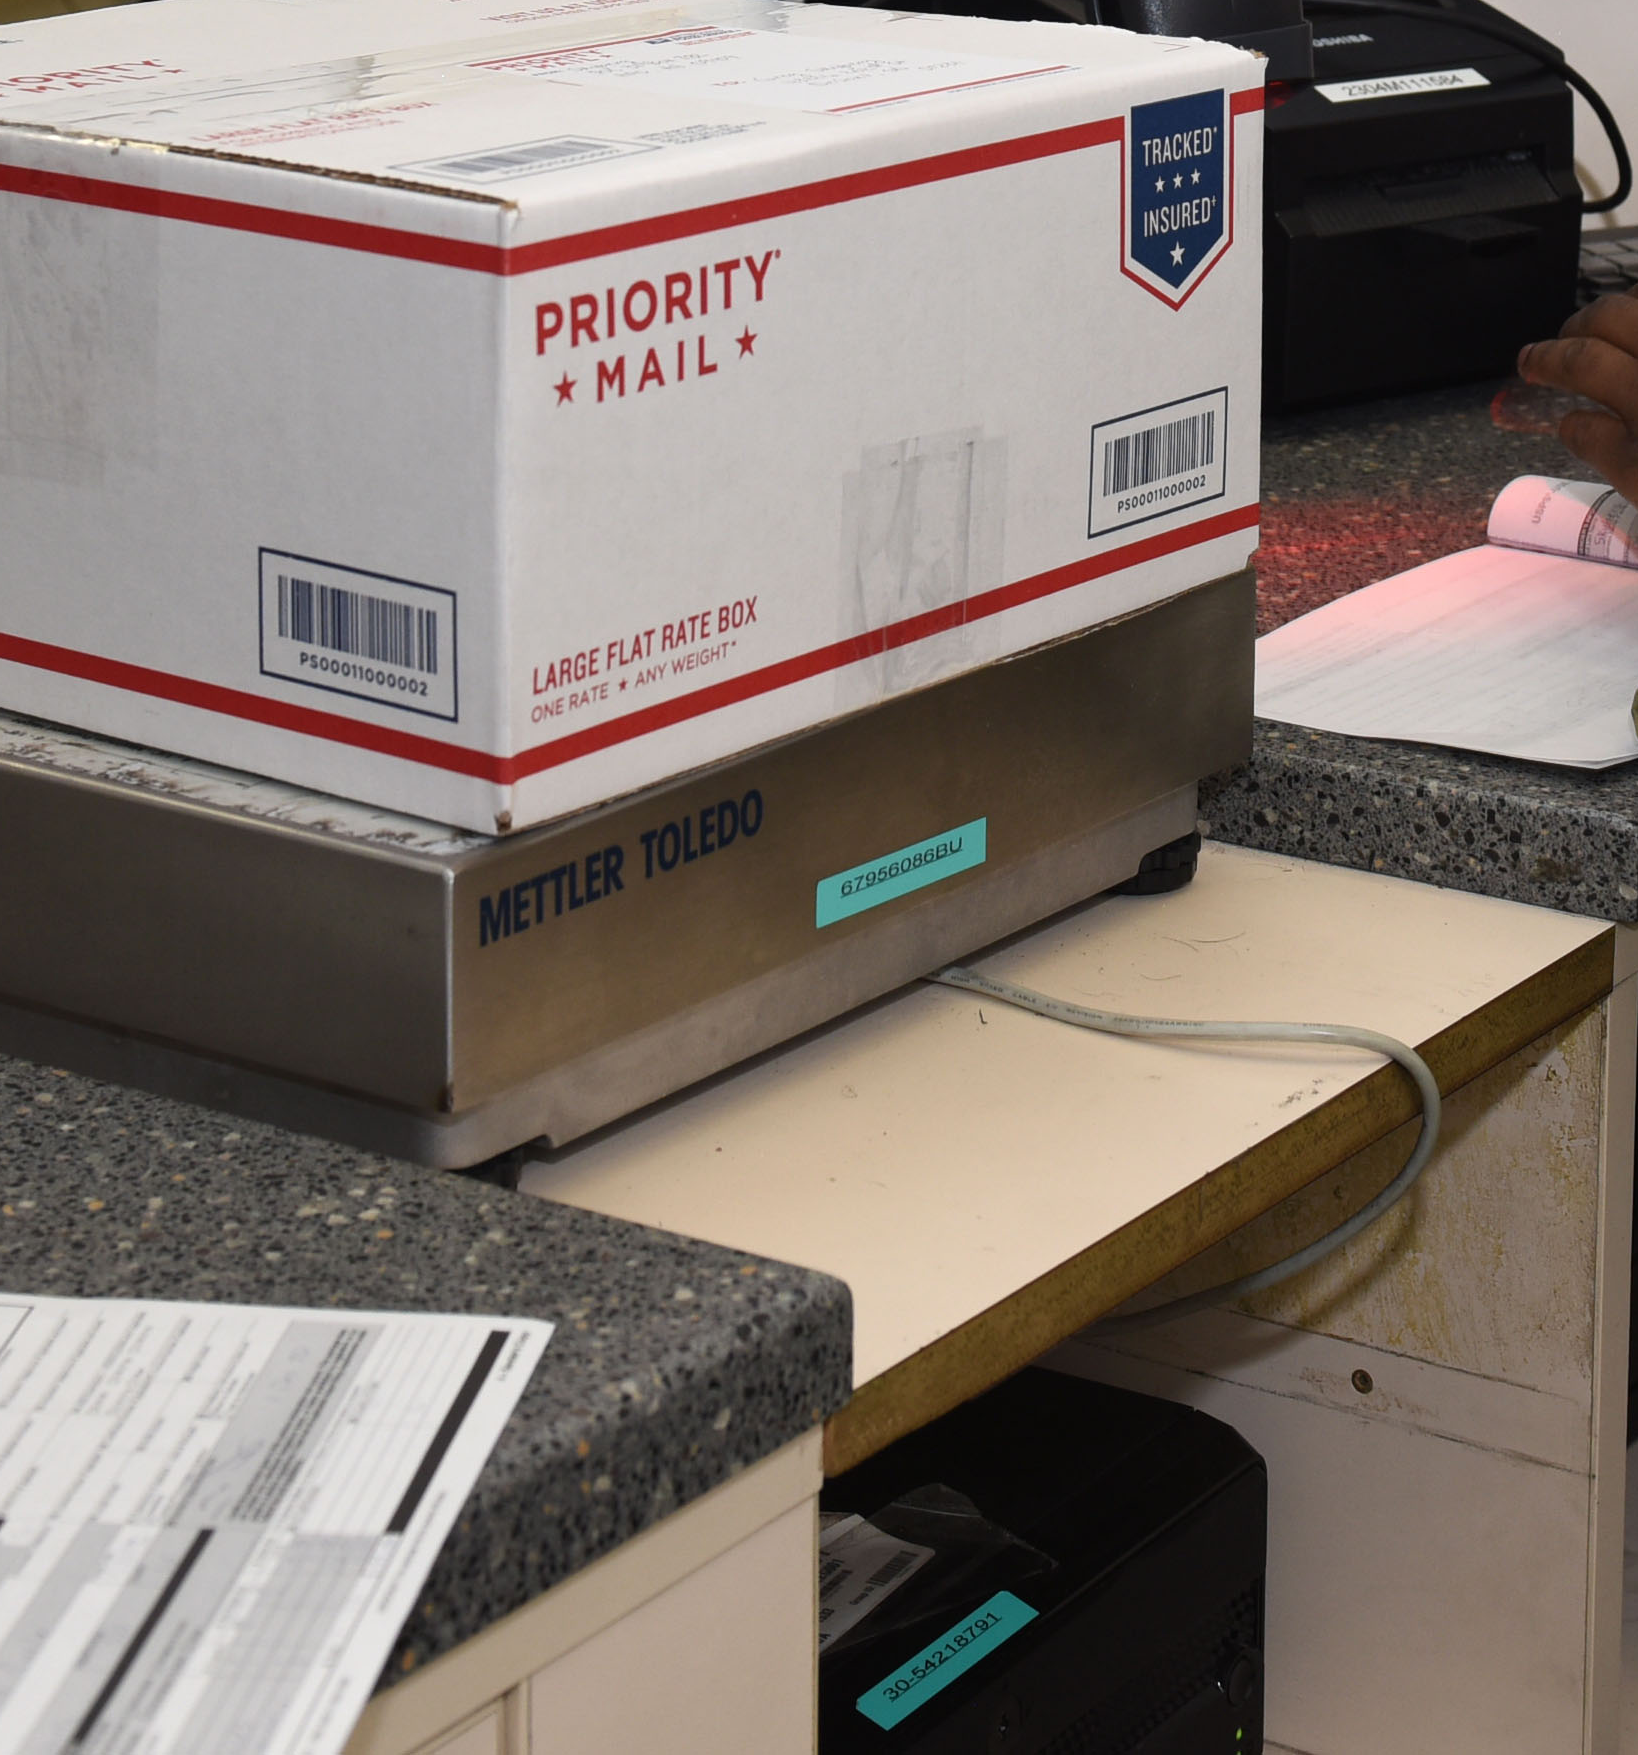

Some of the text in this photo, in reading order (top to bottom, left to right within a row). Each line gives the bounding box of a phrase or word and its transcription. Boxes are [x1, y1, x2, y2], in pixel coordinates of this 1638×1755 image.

[1312, 32, 1375, 49] OSHIBA
[19, 74, 159, 95] MAIL
[535, 252, 773, 357] PRIORITY
[596, 334, 718, 405] MAIL
[1116, 474, 1208, 515] PS00011000002
[298, 649, 430, 698] PS00011000002
[532, 595, 758, 696] LARGE FLAT RATE BOX
[531, 697, 564, 724] ONE
[568, 682, 609, 712] RATE
[635, 664, 668, 687] ANY
[478, 788, 764, 948] METTLER TOLEDO
[840, 834, 965, 899] 67956086BU
[881, 1609, 1001, 1704] 30-54218791
